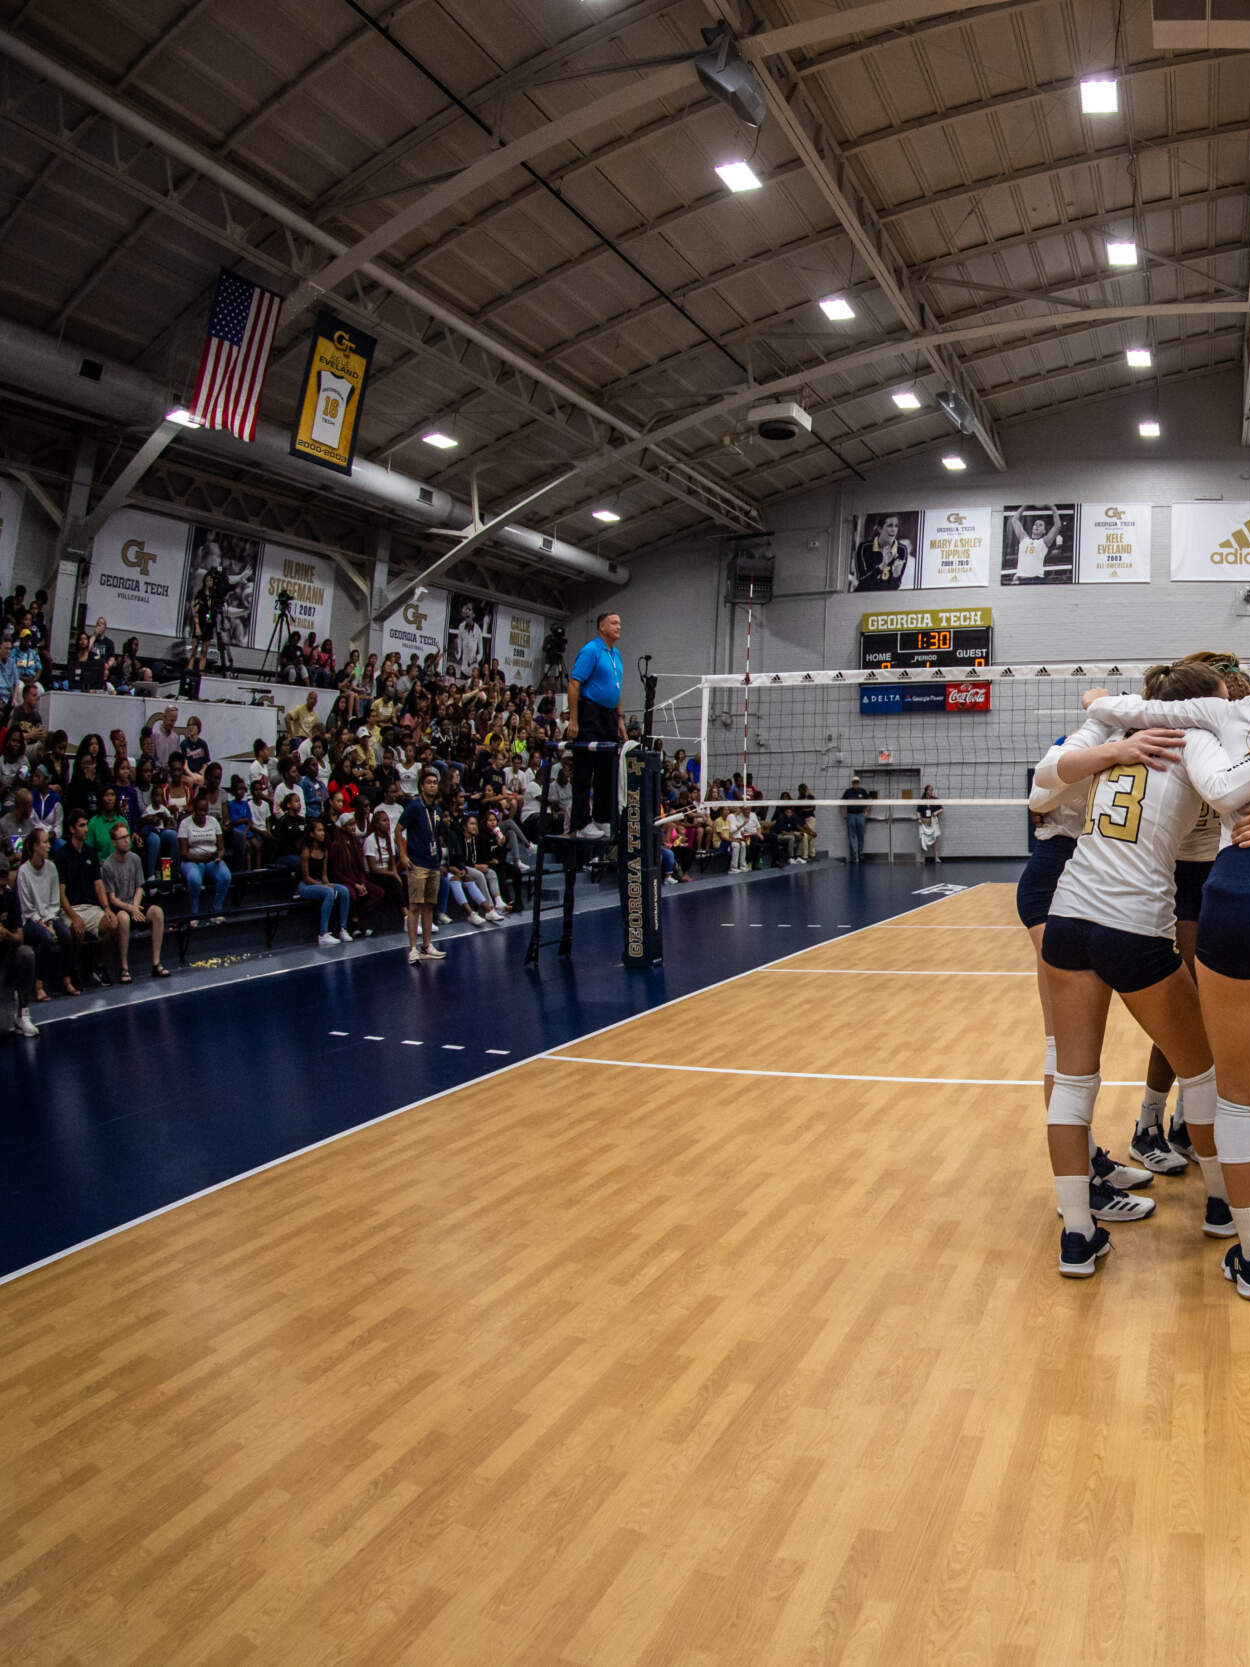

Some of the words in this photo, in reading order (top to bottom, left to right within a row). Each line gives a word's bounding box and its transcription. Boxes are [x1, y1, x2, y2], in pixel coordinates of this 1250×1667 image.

[946, 512, 967, 525] GT
[1104, 506, 1126, 520] GT
[929, 538, 952, 549] MARY
[1105, 533, 1125, 543] KELE
[121, 538, 157, 575] GT
[1097, 544, 1133, 554] EVELAND
[283, 558, 315, 583] ULRIKE
[100, 573, 140, 592] GEORGIA
[144, 581, 169, 597] TECH
[403, 603, 427, 631] GT
[868, 613, 933, 630] GEORGIA
[939, 611, 982, 626] TECH
[389, 629, 417, 643] GEORGIA
[419, 635, 437, 647] TECH
[918, 631, 950, 649] 1:30
[866, 653, 892, 662] HOME
[956, 649, 988, 658] GUEST
[871, 695, 900, 703] DELTA
[1082, 763, 1149, 844] 13
[627, 789, 641, 853] TECH
[628, 857, 644, 958] GEORGIA
